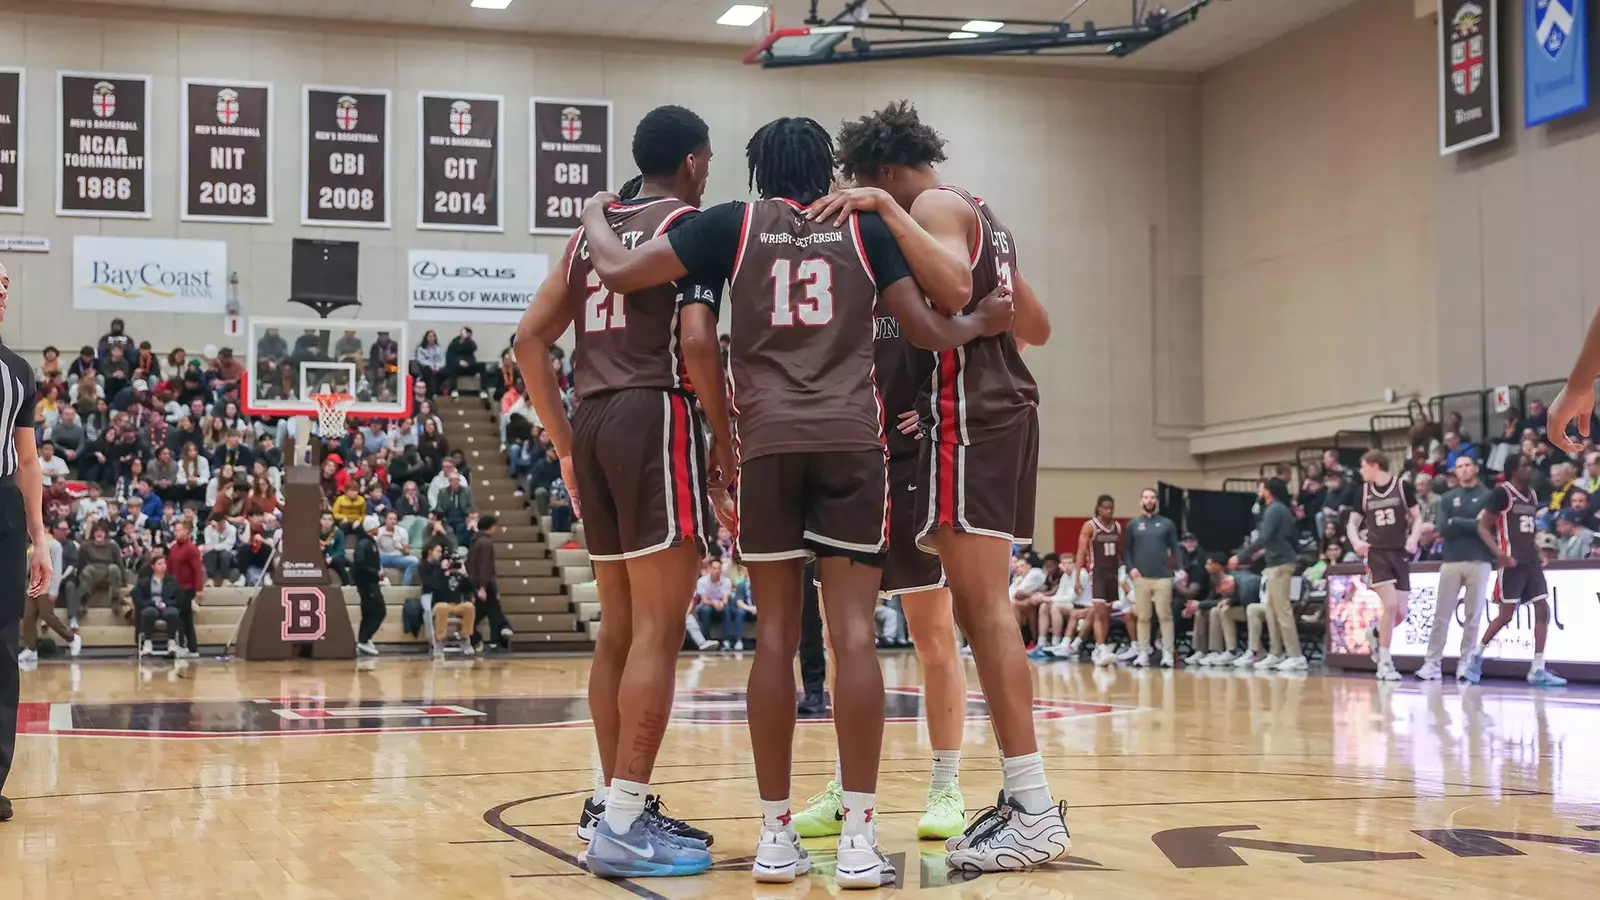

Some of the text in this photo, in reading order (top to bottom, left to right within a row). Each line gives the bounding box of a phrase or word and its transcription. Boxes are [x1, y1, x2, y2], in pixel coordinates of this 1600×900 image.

[94, 119, 138, 131] BASKETBALL
[79, 135, 128, 155] NCAA
[65, 153, 143, 170] TOURNAMENT
[211, 147, 245, 170] NIT
[329, 152, 364, 175] CBI
[444, 157, 477, 180] CIT
[555, 162, 589, 185] CBI
[77, 176, 131, 200] 1986
[200, 181, 256, 205] 2003
[319, 186, 374, 210] 2008
[434, 191, 487, 215] 2014
[546, 196, 591, 218] 201
[760, 231, 843, 248] WRISBY-JEFFERSON
[92, 260, 212, 292] BayCoast
[442, 267, 516, 279] LEXUS
[413, 290, 535, 304] LEXUS OF WARWIC
[584, 267, 627, 333] 21
[770, 257, 834, 327] 13
[1374, 507, 1397, 527] 23
[281, 587, 327, 641] B
